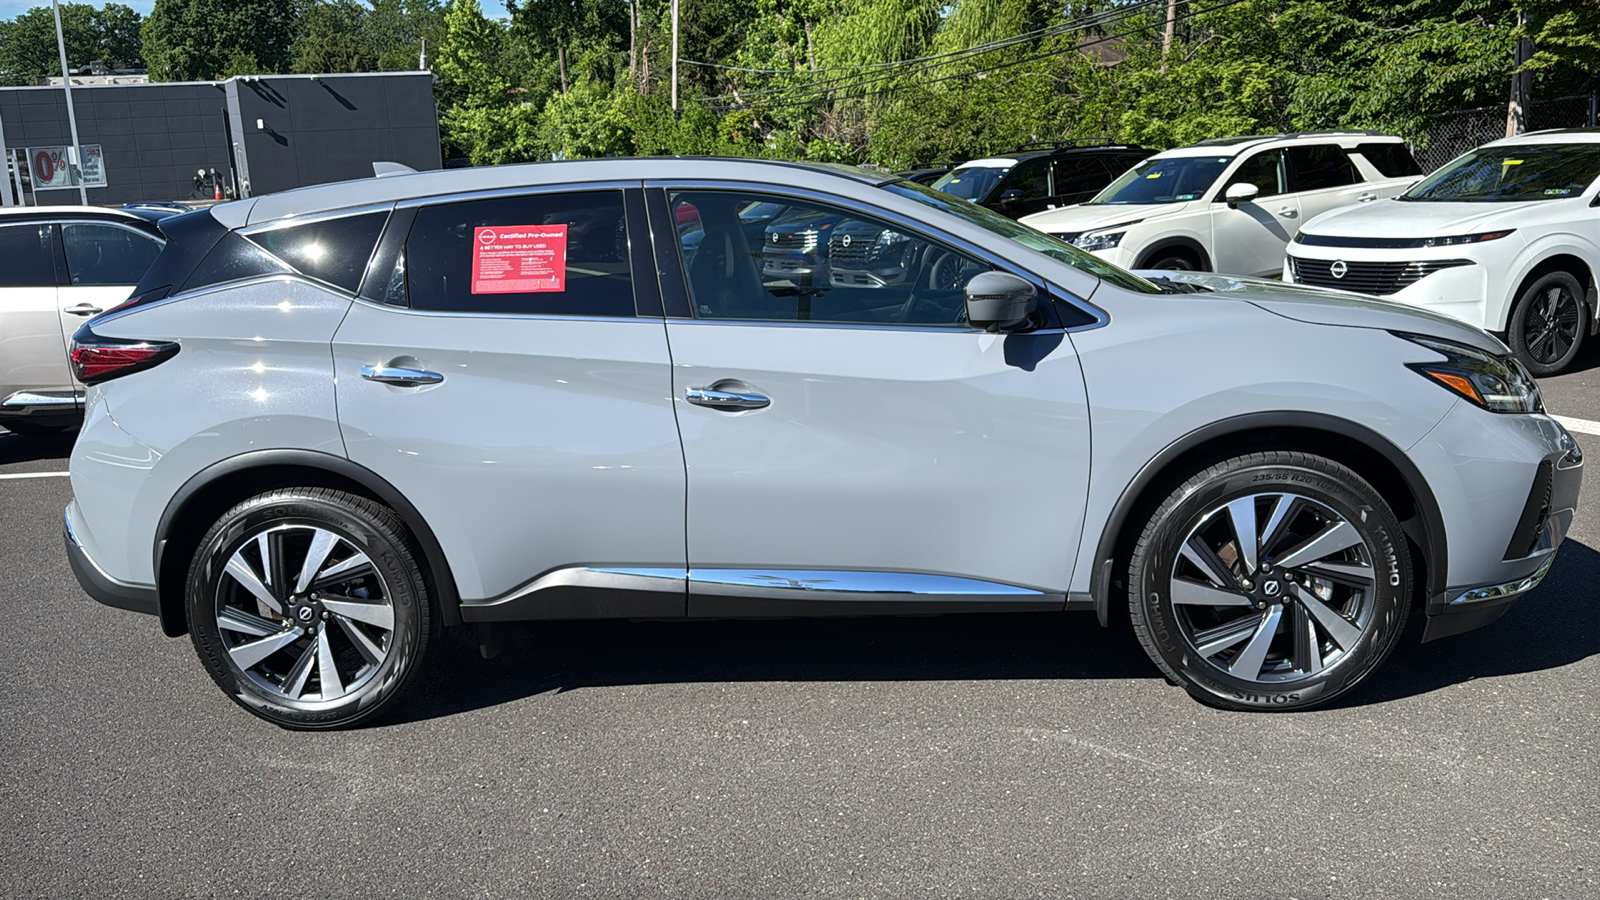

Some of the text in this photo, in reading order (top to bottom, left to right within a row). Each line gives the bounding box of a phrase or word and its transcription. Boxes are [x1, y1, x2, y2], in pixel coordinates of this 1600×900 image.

[36, 151, 66, 183] 0%
[1252, 473, 1289, 482] 235/55
[1290, 474, 1312, 483] R20
[1374, 525, 1400, 586] KUMHO
[380, 551, 412, 608] KUMHO
[1232, 691, 1301, 704] SOLUS
